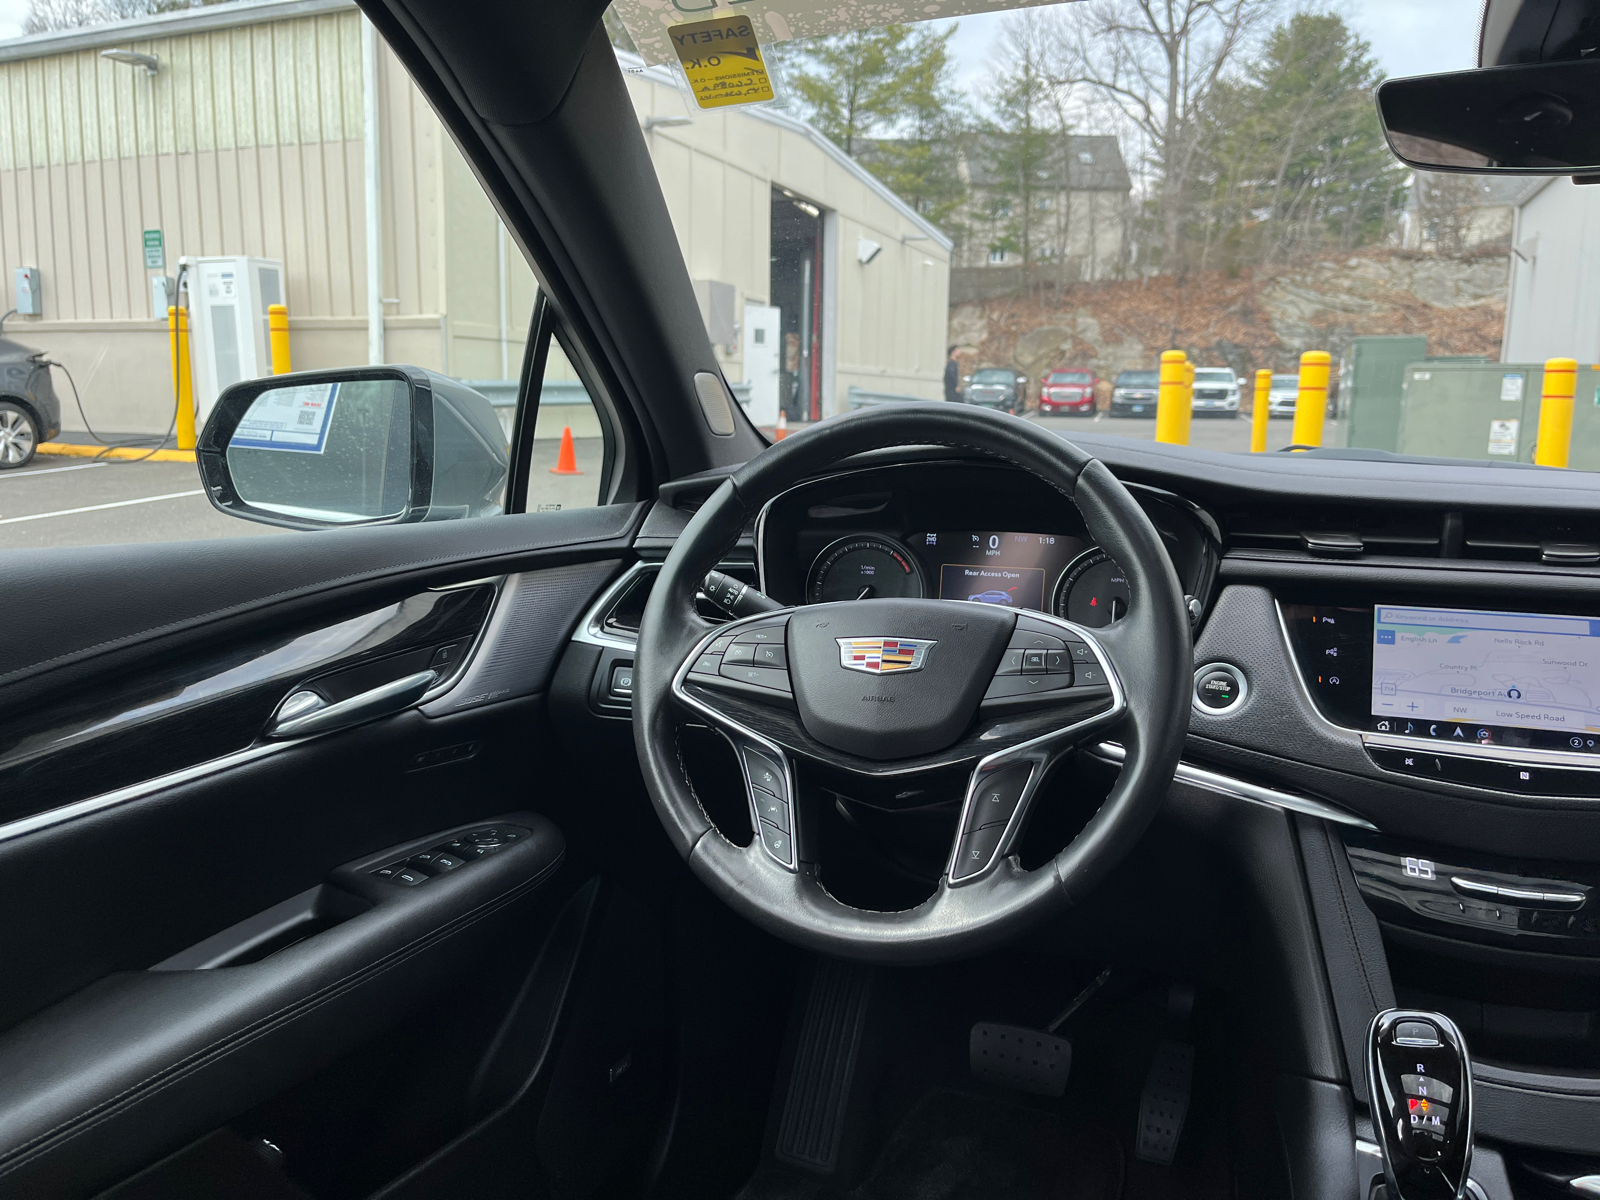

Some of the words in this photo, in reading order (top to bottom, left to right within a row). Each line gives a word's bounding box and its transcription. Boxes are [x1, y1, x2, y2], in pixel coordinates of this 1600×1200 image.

[988, 535, 999, 549] 0
[1439, 663, 1468, 671] Country
[1450, 687, 1496, 697] Bridgeport
[1515, 712, 1541, 720] Speed
[1406, 857, 1432, 878] 65
[1417, 1064, 1424, 1072] R
[1419, 1086, 1427, 1095] N
[1409, 1098, 1418, 1109] P
